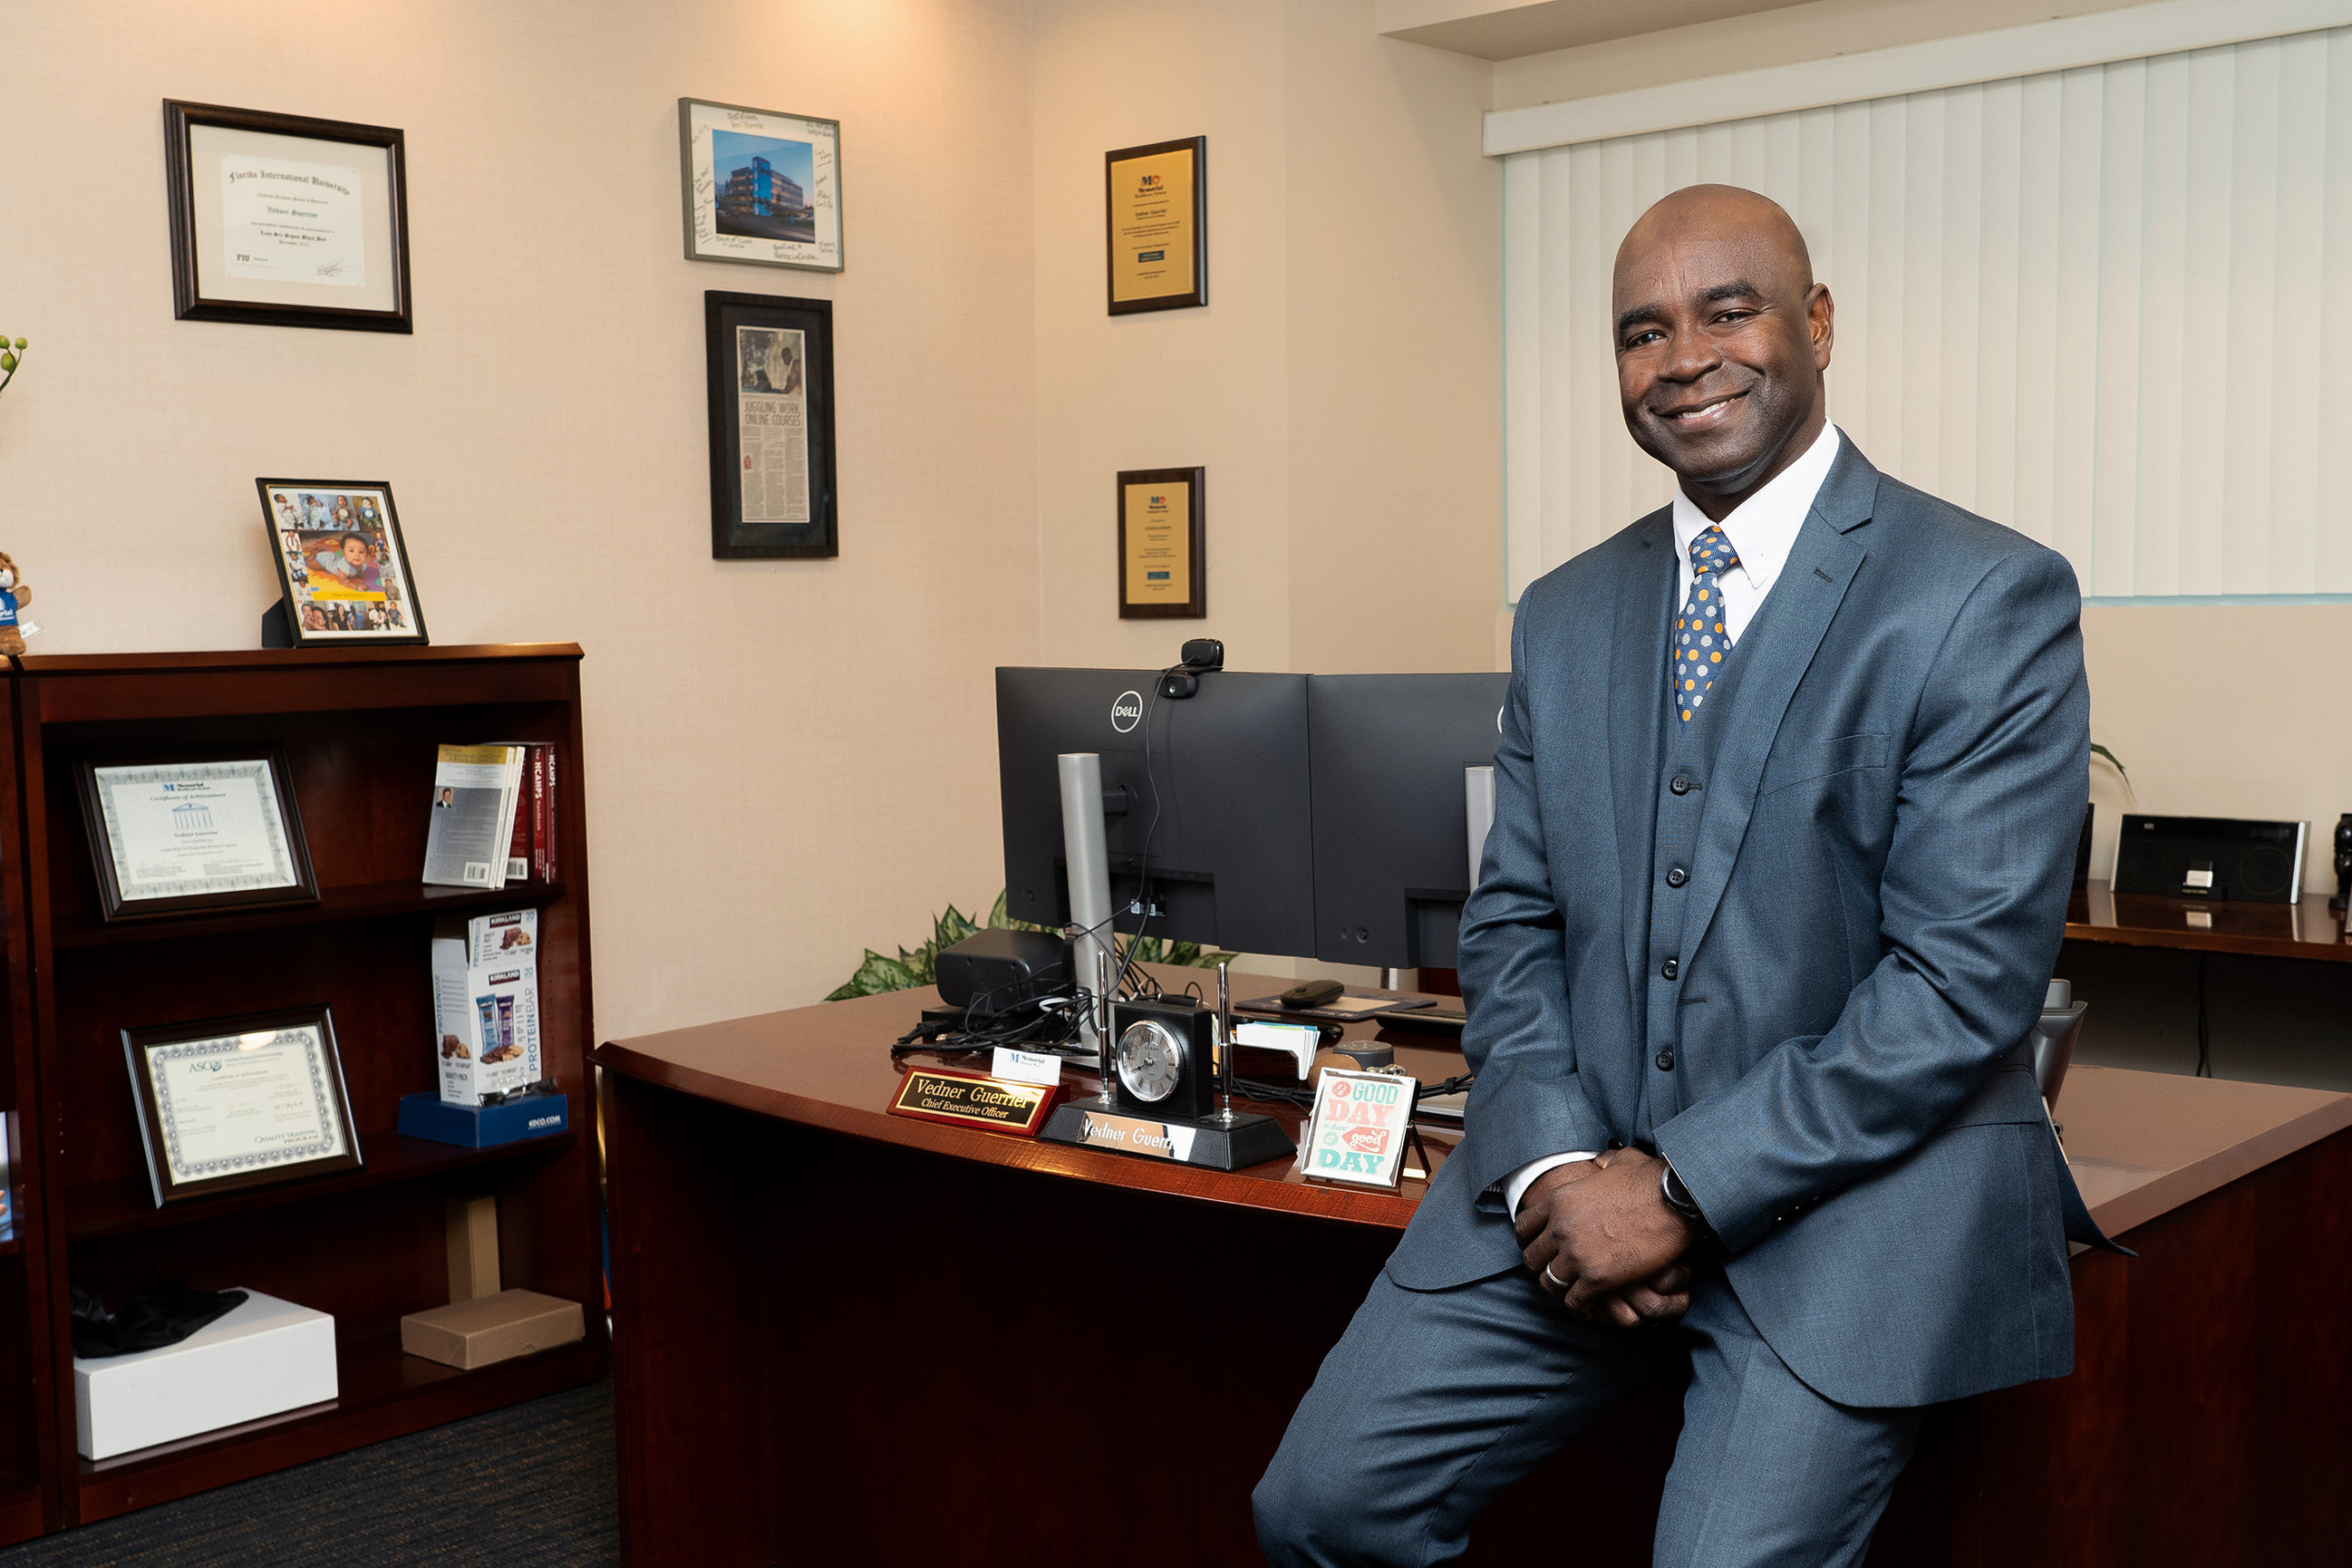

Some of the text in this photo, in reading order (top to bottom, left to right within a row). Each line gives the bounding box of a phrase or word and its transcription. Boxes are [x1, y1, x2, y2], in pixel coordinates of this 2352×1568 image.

[260, 170, 309, 184] International
[312, 177, 351, 197] University
[237, 254, 250, 262] FIU
[744, 401, 777, 413] JUGGLING
[745, 412, 801, 427] ONLINE COURSES
[1115, 705, 1138, 717] DELL
[534, 761, 543, 799] HCAHPS
[490, 911, 535, 924] KIRKLAND 20
[489, 966, 533, 982] KIRKLAND 20
[1021, 1055, 1045, 1064] Memorial
[916, 1079, 1031, 1109] Vedner Guerrier
[1352, 1082, 1399, 1104] GOOD
[921, 1098, 1010, 1119] Chief Executive Officer
[1325, 1098, 1396, 1127] DAY
[1084, 1118, 1128, 1141] Vedner
[1331, 1122, 1349, 1132] have
[254, 1134, 285, 1143] QUALITY
[284, 1135, 318, 1144] PROGRAM
[1349, 1129, 1388, 1152] good
[1318, 1148, 1385, 1175] DAY
